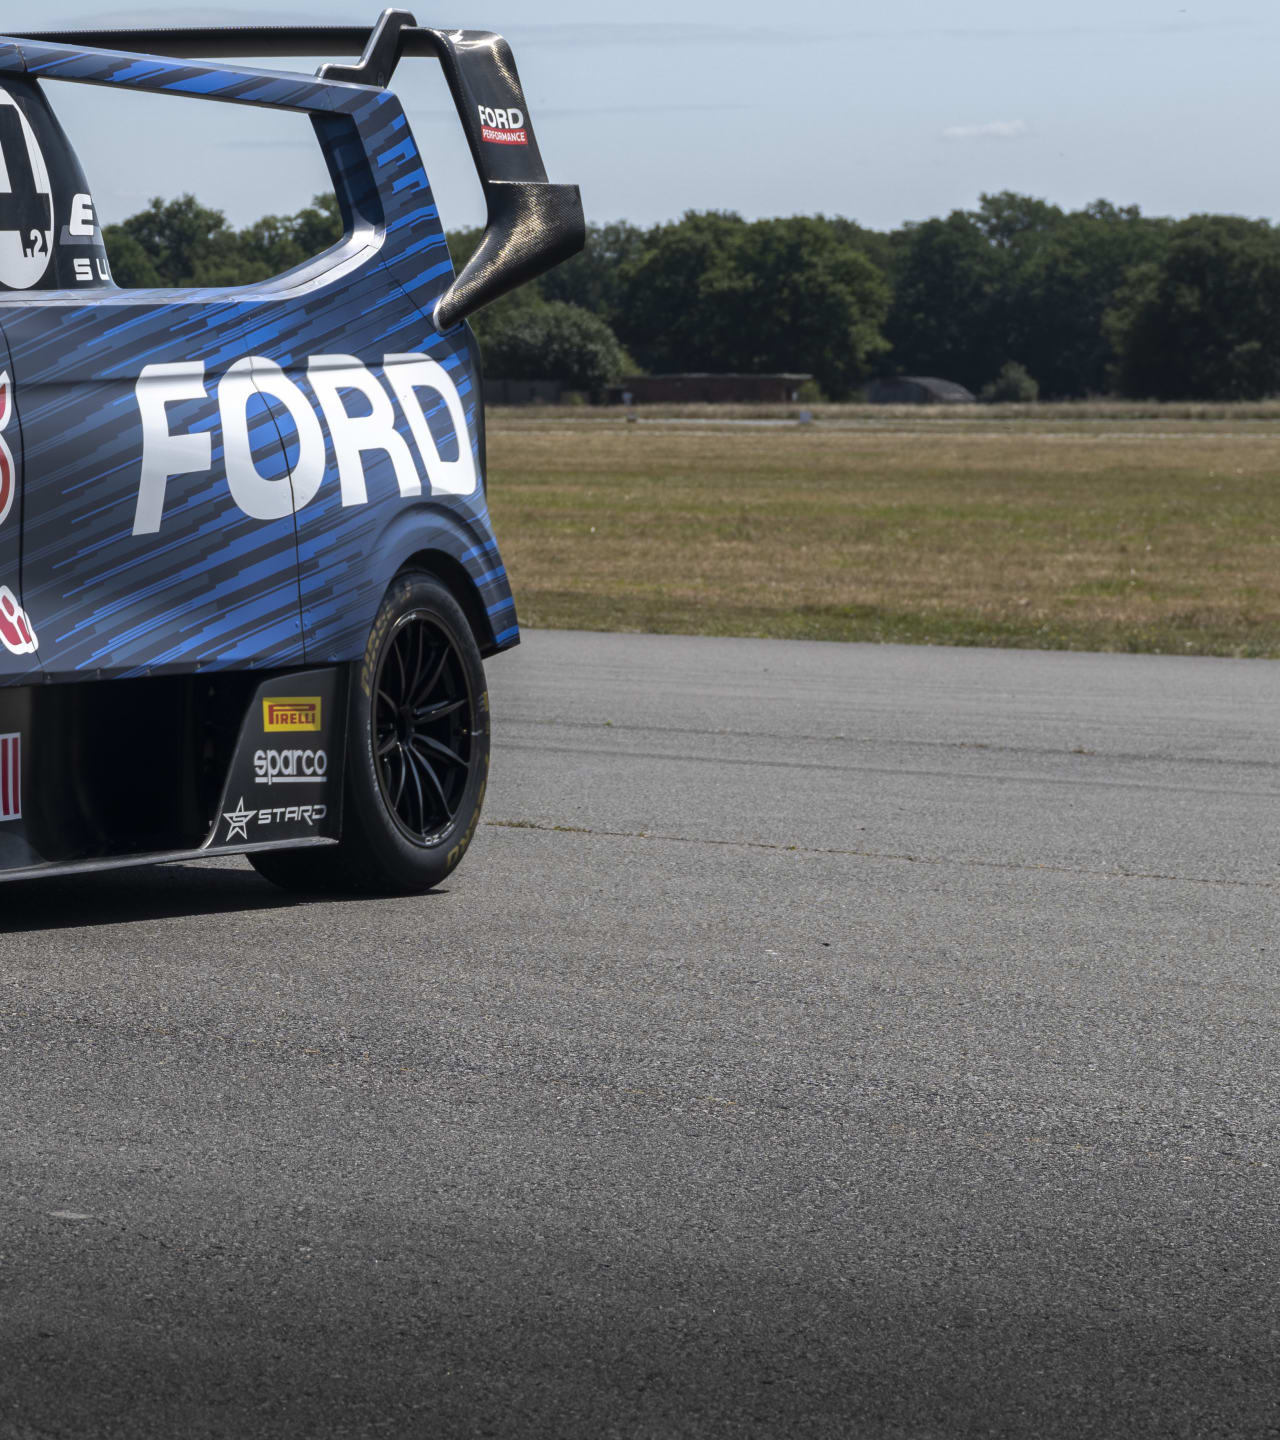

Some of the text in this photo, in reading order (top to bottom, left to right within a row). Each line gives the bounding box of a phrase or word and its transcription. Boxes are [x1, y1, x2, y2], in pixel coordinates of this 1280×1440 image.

[477, 104, 524, 129] FORD
[481, 128, 526, 142] PERFORMANCE
[132, 353, 477, 536] FORD
[267, 703, 317, 725] PIRELLI
[253, 749, 328, 786] sparco
[257, 804, 328, 826] STARD
